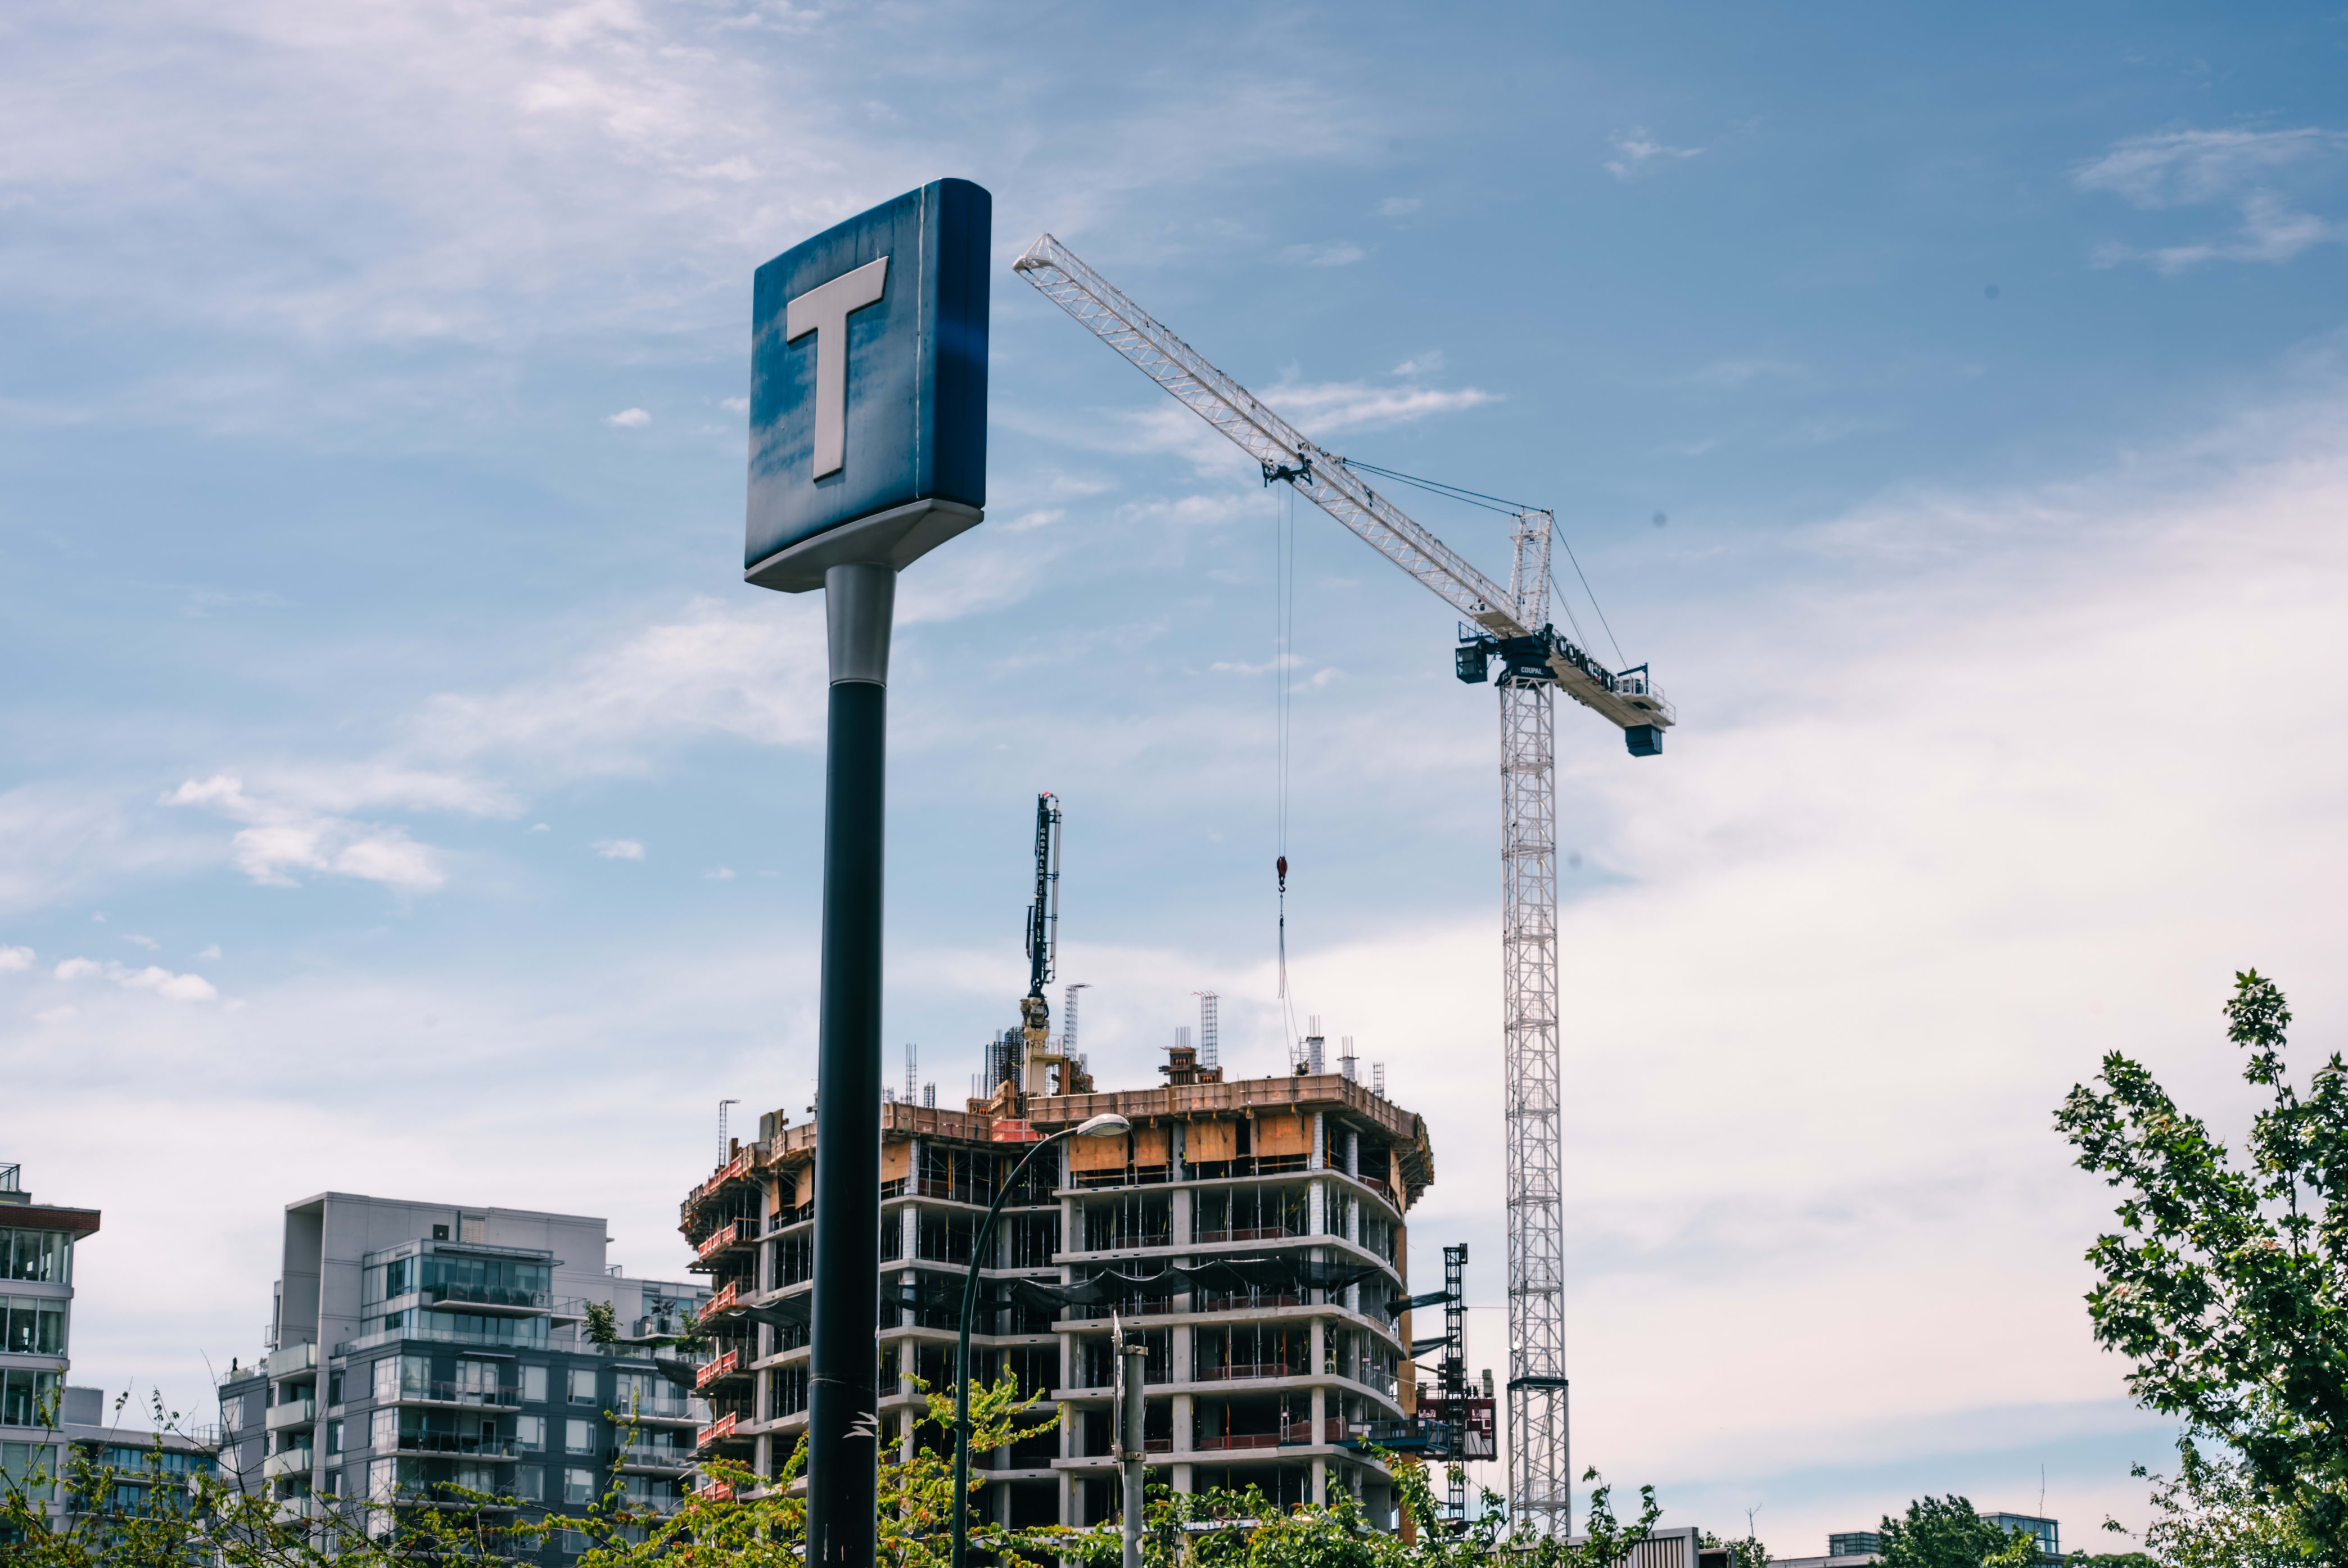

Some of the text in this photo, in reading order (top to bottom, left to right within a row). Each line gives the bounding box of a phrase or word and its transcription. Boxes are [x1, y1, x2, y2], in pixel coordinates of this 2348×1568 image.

[787, 255, 889, 482] T
[1521, 666, 1544, 675] COUPAL
[1556, 636, 1616, 693] CONCERT
[1131, 1104, 1144, 1113] 26
